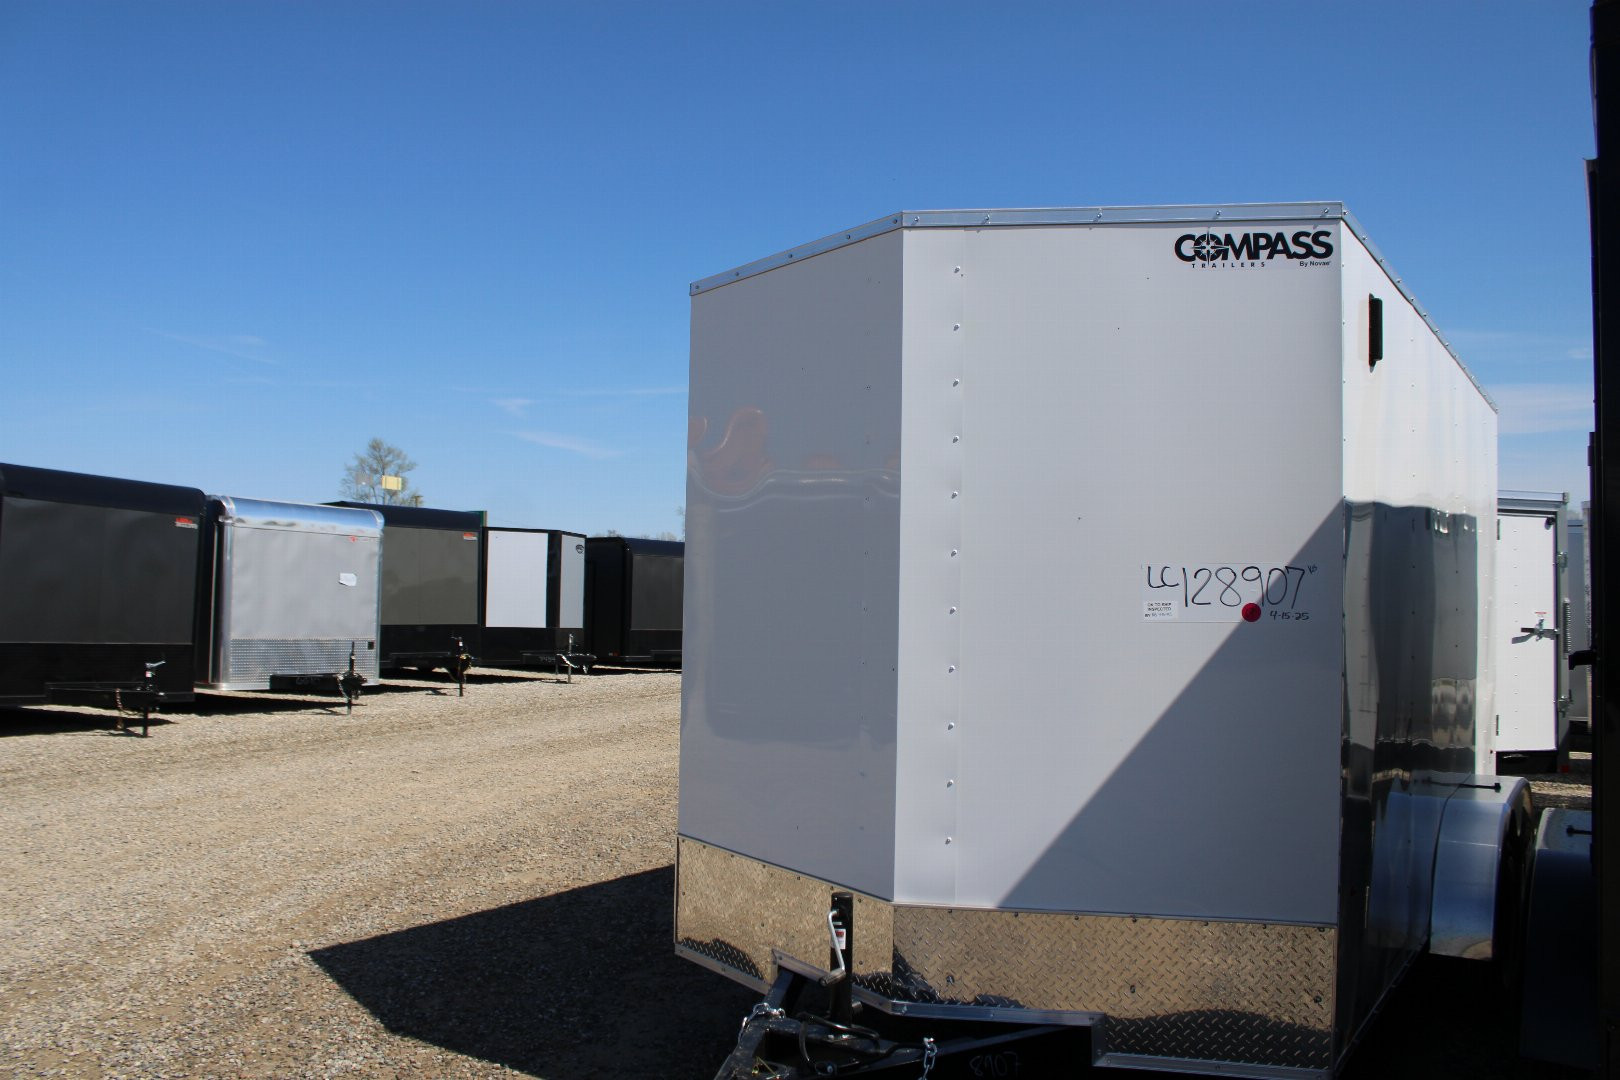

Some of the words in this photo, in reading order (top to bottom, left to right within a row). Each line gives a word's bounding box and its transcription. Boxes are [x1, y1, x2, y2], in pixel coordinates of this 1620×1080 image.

[1174, 230, 1334, 262] COMPASS
[1191, 261, 1266, 269] TRAILERS
[1299, 260, 1308, 268] By
